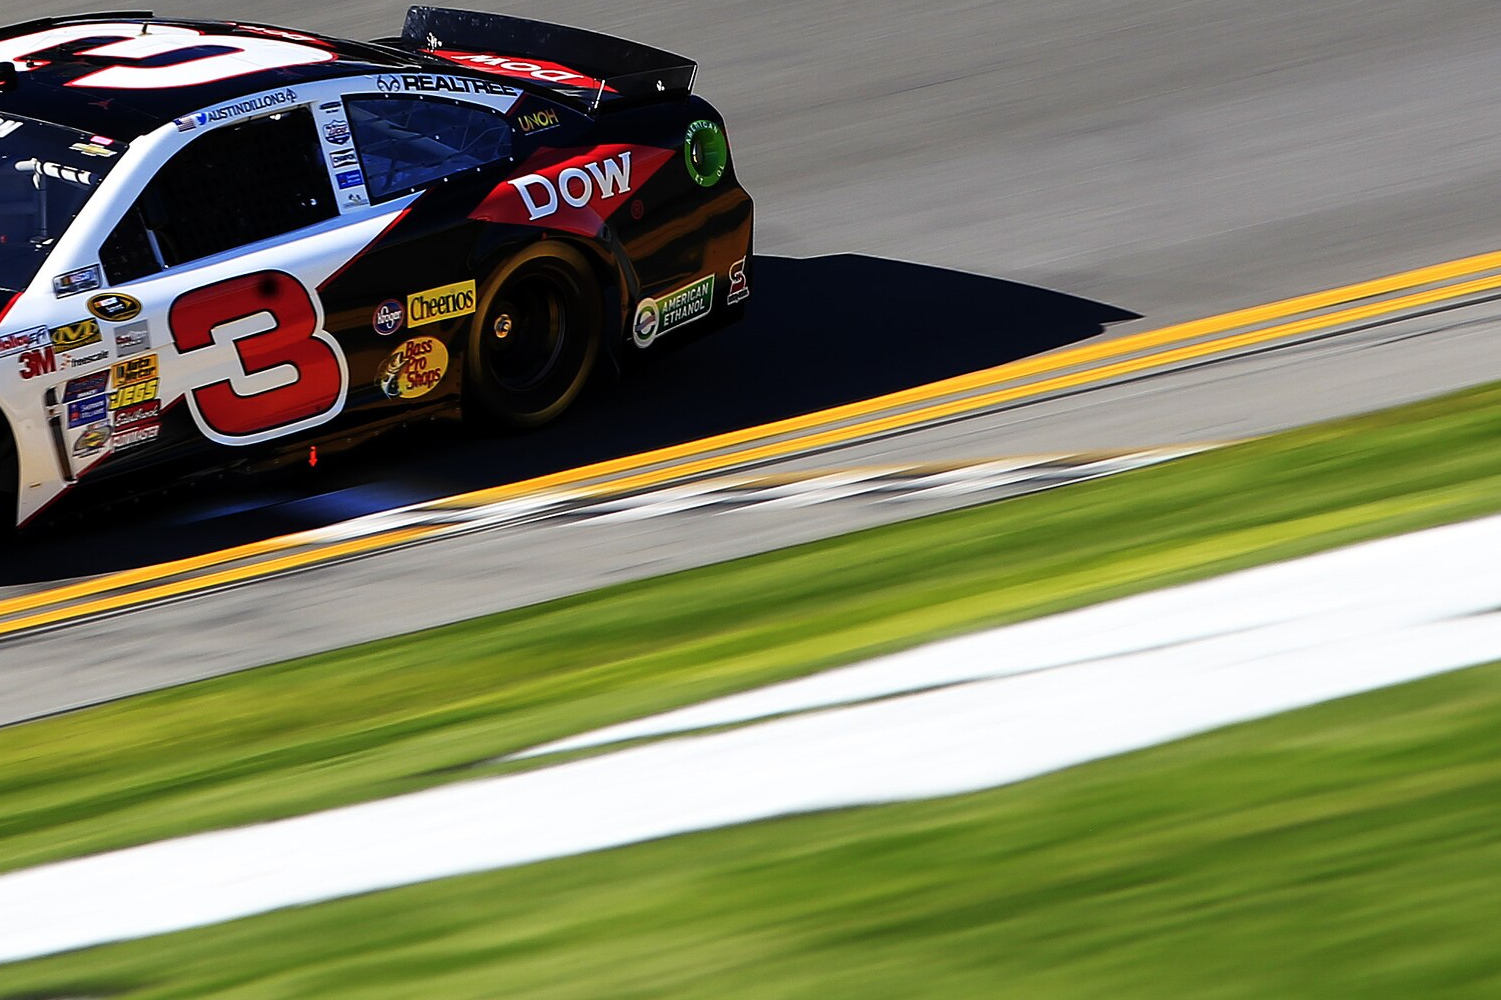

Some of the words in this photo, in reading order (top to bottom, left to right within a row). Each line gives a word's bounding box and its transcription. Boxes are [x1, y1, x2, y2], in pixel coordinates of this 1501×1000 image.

[451, 54, 584, 82] DOW
[404, 75, 518, 97] REALTREE
[207, 91, 286, 123] AUSTINDILLON3
[518, 109, 559, 133] UNOH
[685, 121, 719, 145] AMERICAN
[508, 151, 631, 221] DOW
[410, 289, 474, 321] Cheerios
[661, 282, 709, 314] AMERICAN
[663, 298, 705, 326] ETHANOL
[377, 306, 403, 329] Kroger
[18, 346, 56, 379] 3M
[169, 269, 348, 446] 3
[403, 340, 432, 357] Bass
[406, 356, 426, 374] Pro
[406, 368, 441, 389] Shops
[109, 380, 157, 410] JEGS
